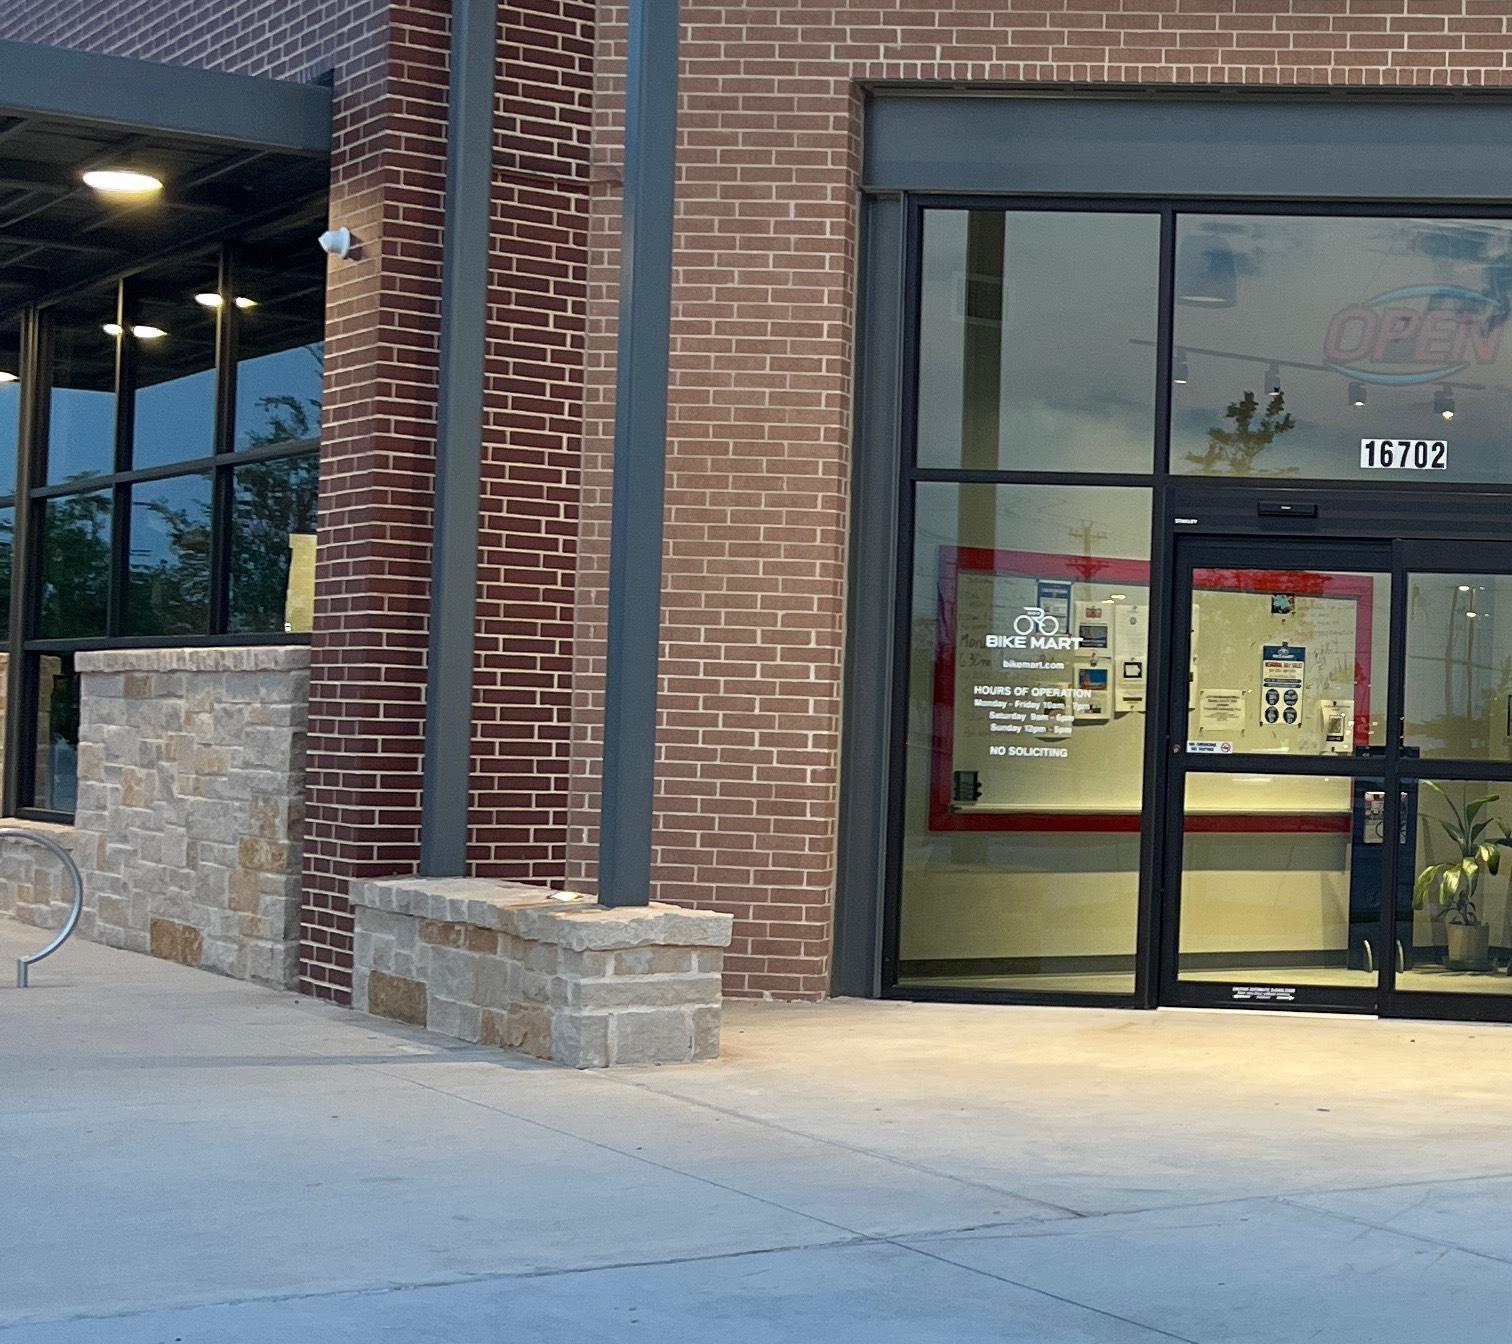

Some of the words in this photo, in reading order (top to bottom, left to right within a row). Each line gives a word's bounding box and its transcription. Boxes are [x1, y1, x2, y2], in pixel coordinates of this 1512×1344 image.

[1323, 302, 1503, 365] OPEN
[1365, 440, 1446, 469] 16702
[985, 634, 1027, 649] BIKE
[1030, 636, 1084, 651] MART
[1002, 659, 1065, 671] bikemart.com
[974, 685, 1012, 696] HOURS
[1014, 686, 1029, 697] OF
[1031, 687, 1092, 699] OPERATION
[1014, 699, 1041, 711] Friday
[989, 745, 1006, 756] NO
[1008, 746, 1068, 758] SOLICITING
